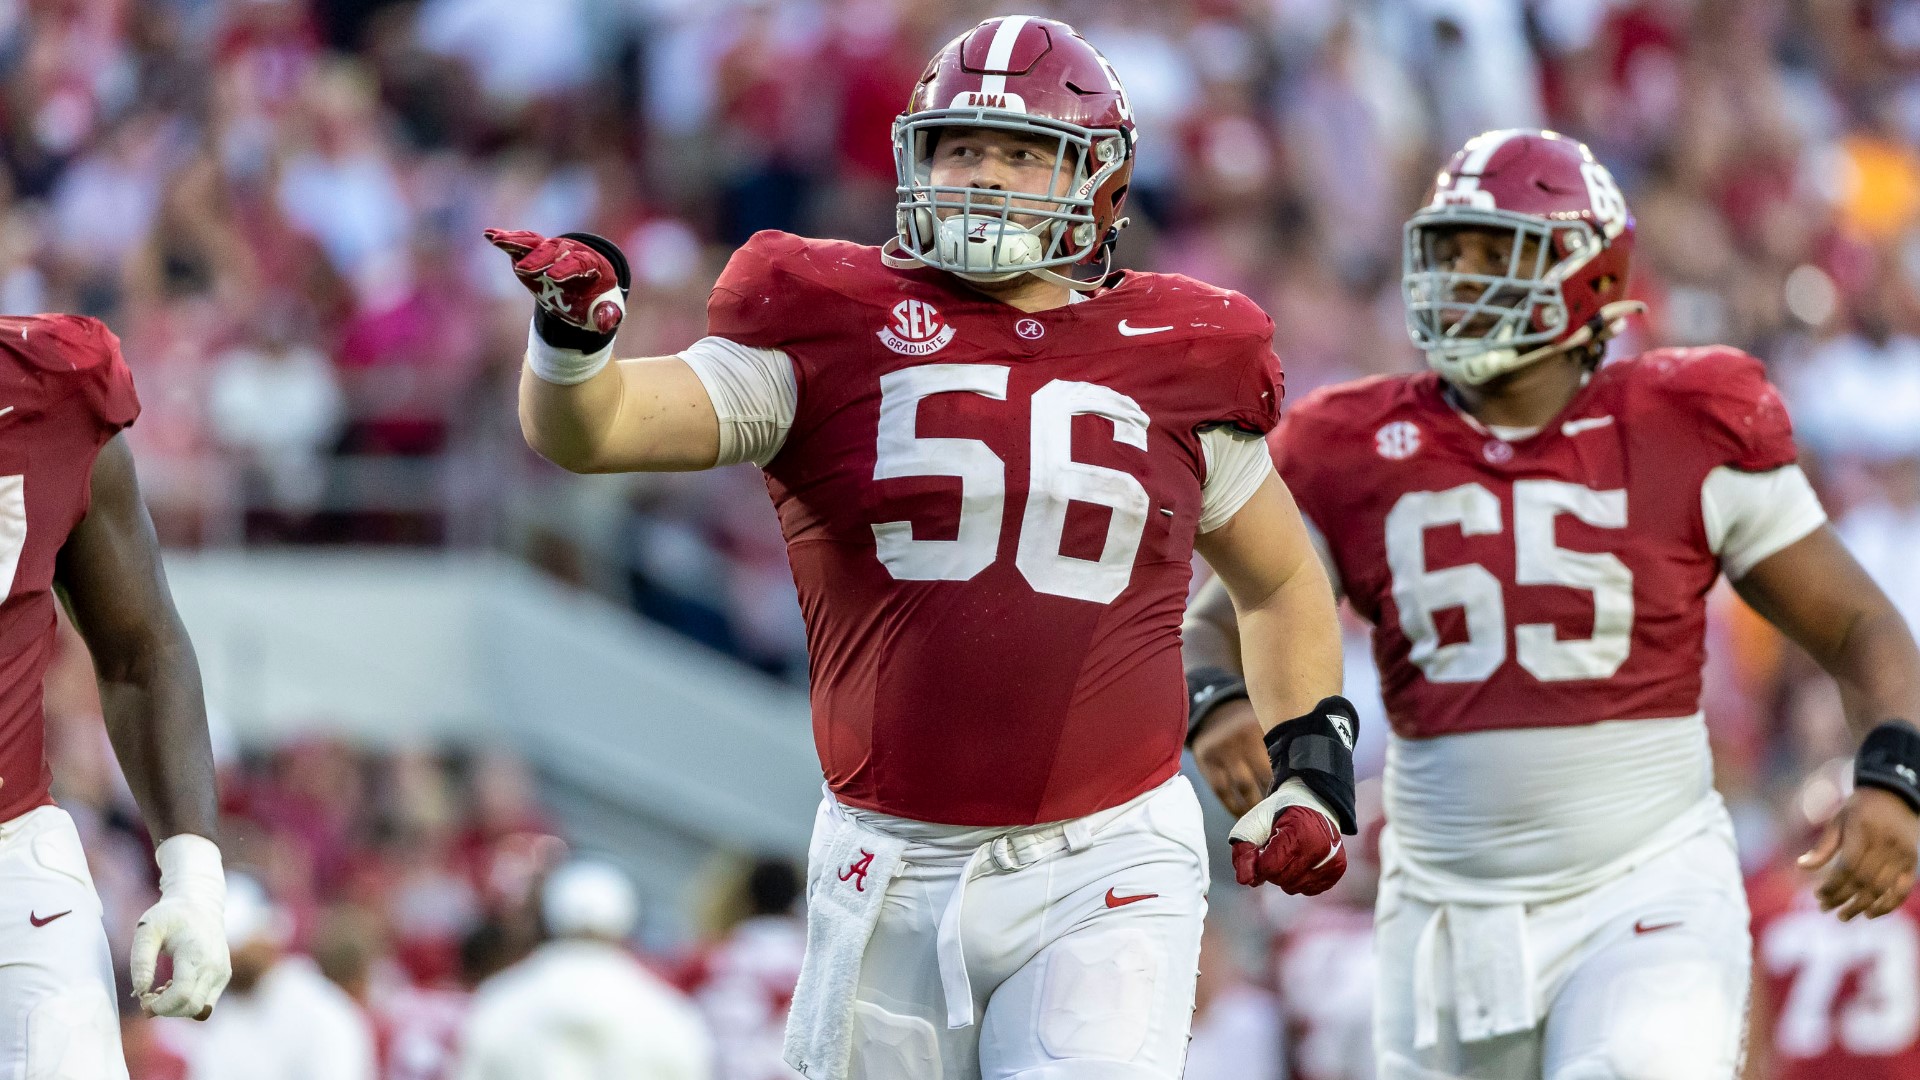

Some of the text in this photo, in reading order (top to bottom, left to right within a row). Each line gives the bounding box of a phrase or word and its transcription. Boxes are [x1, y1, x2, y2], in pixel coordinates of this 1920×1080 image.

[968, 93, 1007, 108] BAMA
[892, 299, 939, 339] SEC
[887, 335, 946, 354] GRADUATE
[870, 363, 1151, 605] 56
[1385, 479, 1635, 682] 65
[838, 847, 875, 893] A
[1761, 903, 1920, 1058] 73
